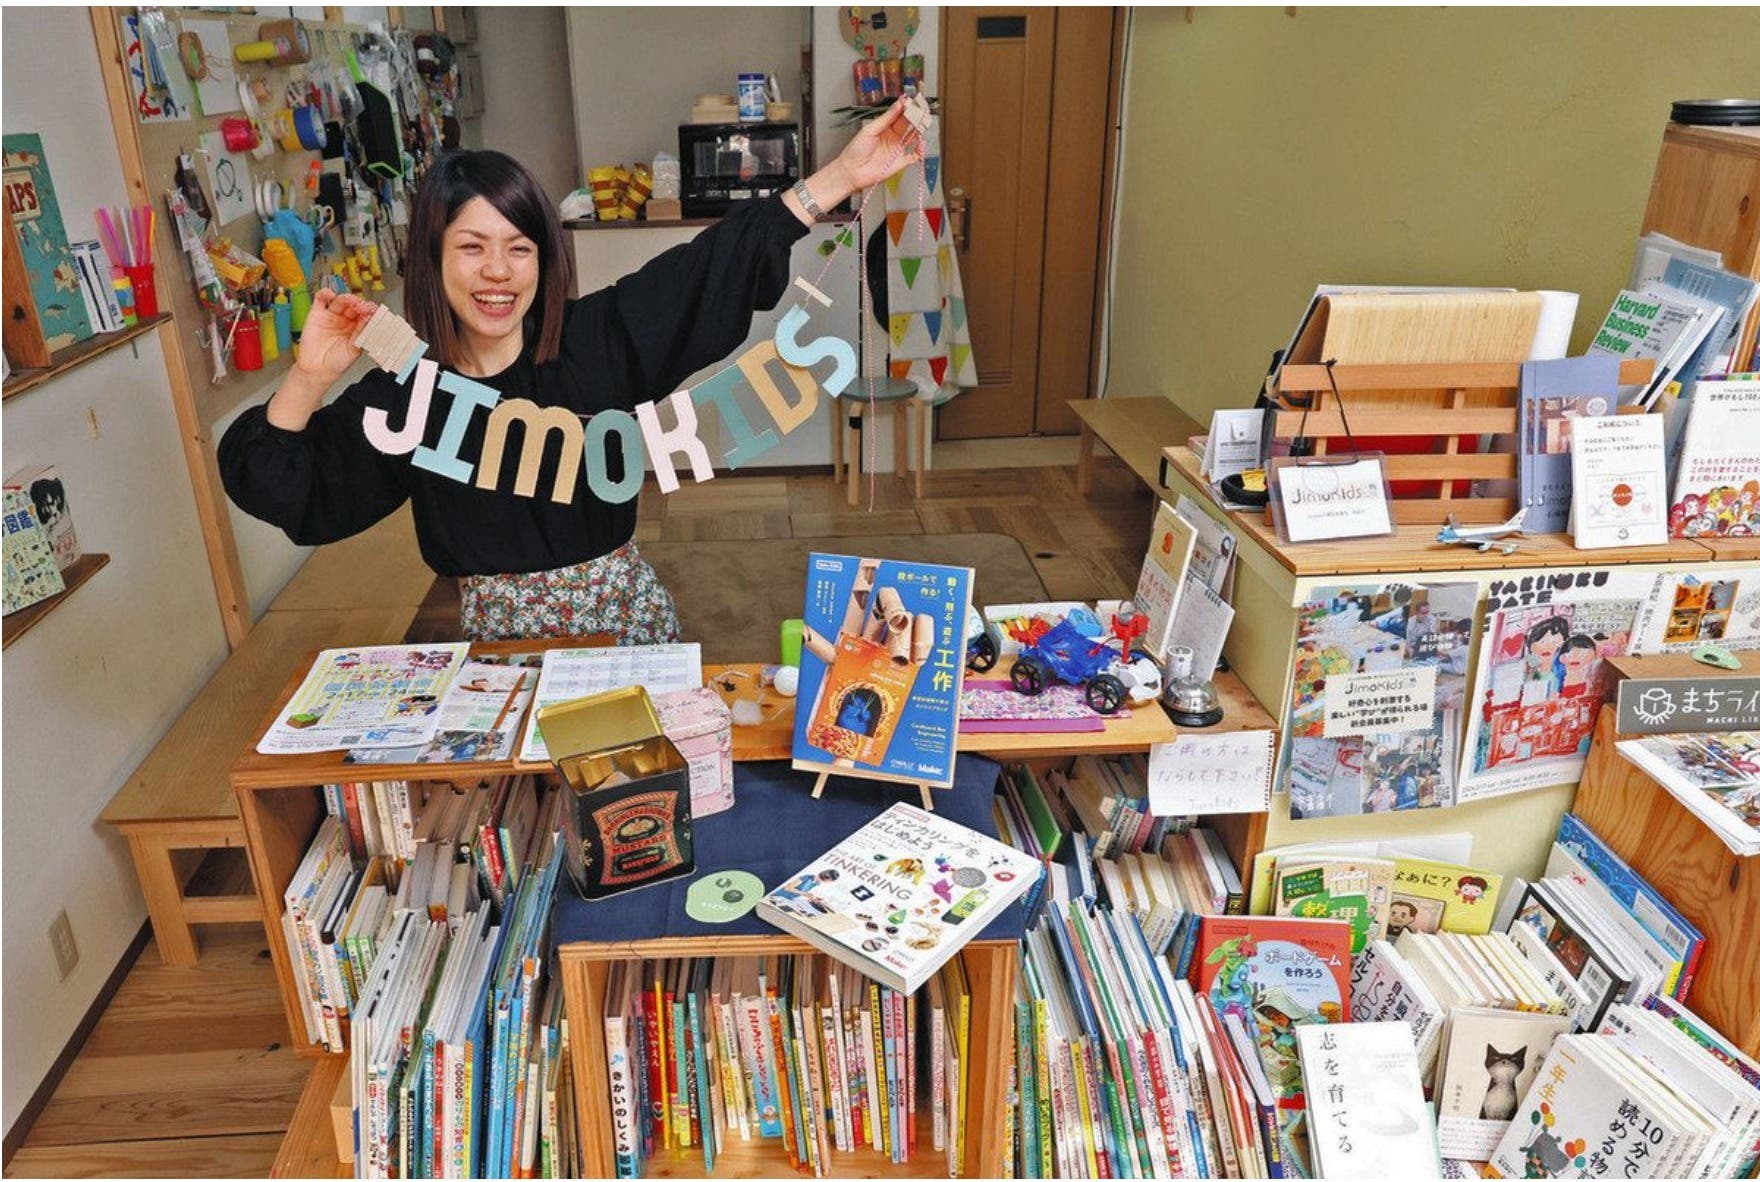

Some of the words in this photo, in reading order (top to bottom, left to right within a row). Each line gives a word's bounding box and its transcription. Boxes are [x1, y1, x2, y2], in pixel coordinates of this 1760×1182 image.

[1613, 294, 1662, 320] Harvard
[1604, 312, 1651, 340] Business
[1594, 330, 1633, 354] Review
[2, 510, 34, 537] 図鑑
[932, 648, 956, 693] 工作
[1681, 687, 1760, 713] まちライ
[1706, 717, 1738, 725] MACHI
[870, 819, 935, 851] はじめよう
[821, 853, 914, 902] TINKERING
[1264, 948, 1342, 967] ボードゲーム
[1284, 966, 1323, 980] を作ろう
[1538, 1049, 1577, 1105] 一年生
[1319, 1031, 1353, 1154] 志を育てる
[1624, 1117, 1664, 1179] 10分で
